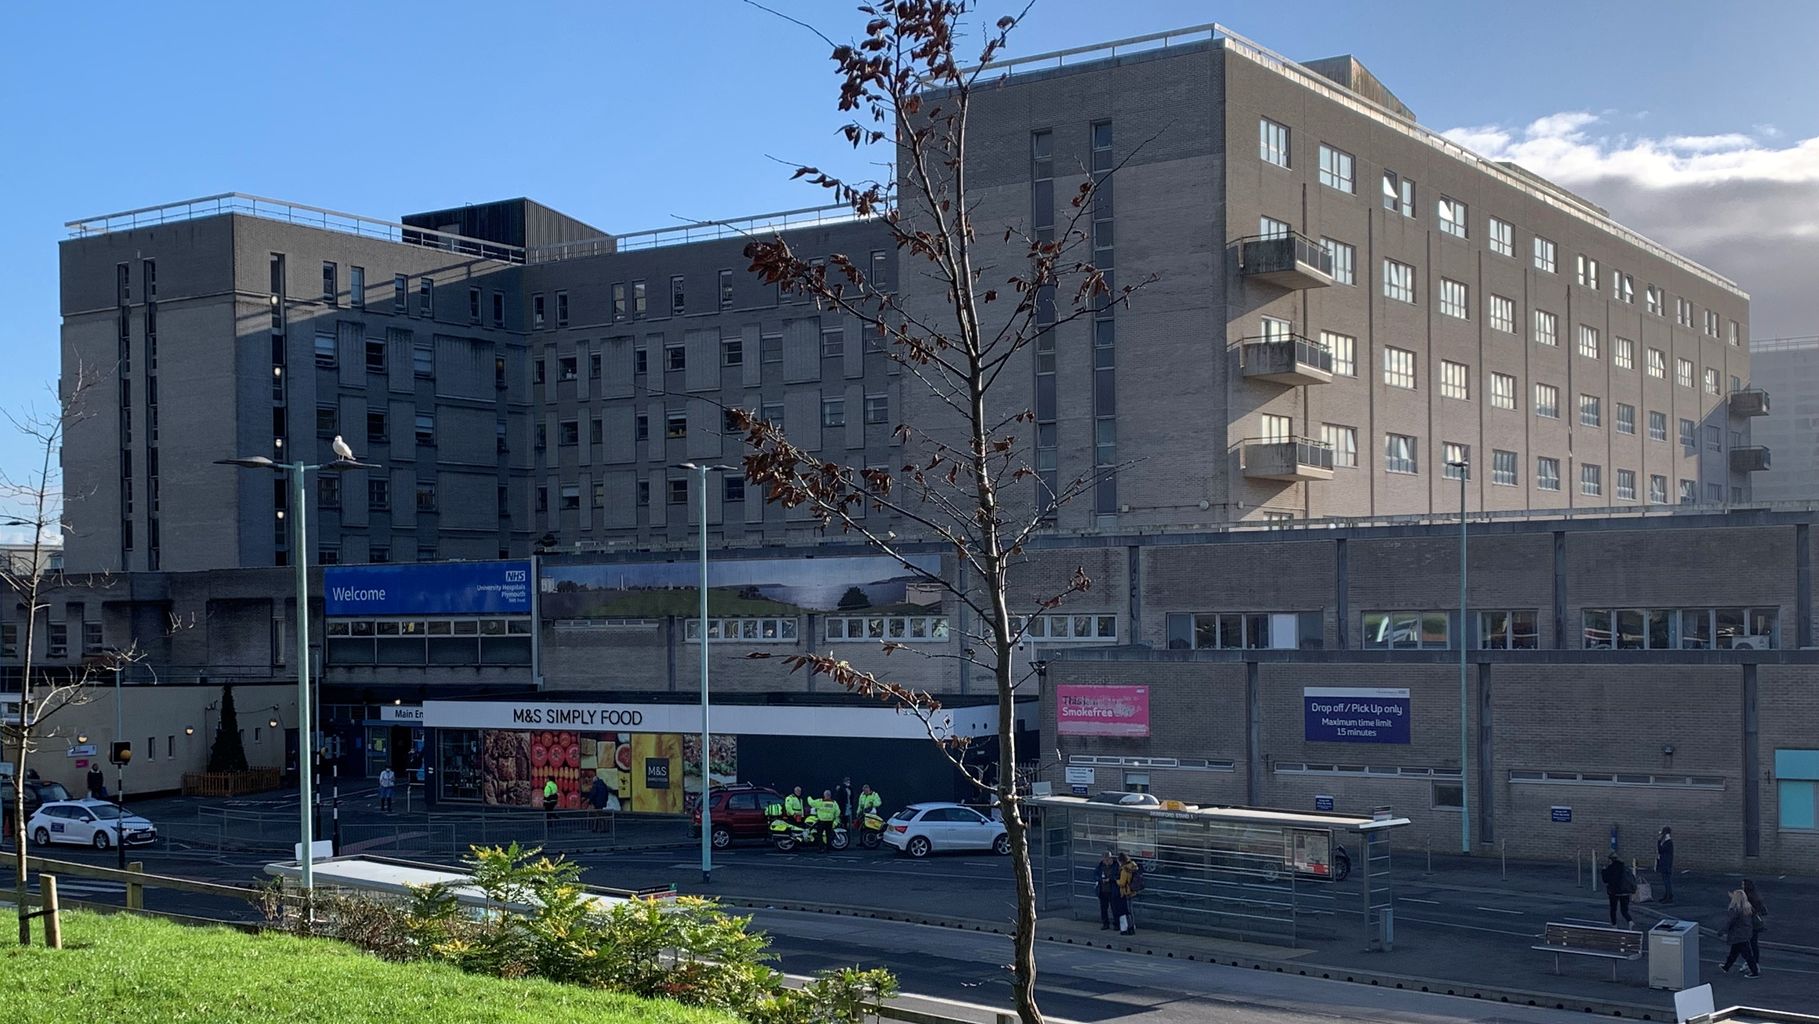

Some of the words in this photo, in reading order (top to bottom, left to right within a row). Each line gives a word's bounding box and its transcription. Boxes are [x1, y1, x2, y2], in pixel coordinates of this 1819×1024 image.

[506, 571, 525, 581] NHS
[332, 586, 386, 601] Welcome
[501, 591, 525, 599] Plymouth
[395, 709, 413, 718] Main
[1062, 706, 1114, 717] Smokefree
[1311, 703, 1332, 714] Drop
[1333, 703, 1345, 712] off
[1351, 703, 1370, 713] Pick
[1370, 704, 1383, 715] Up
[1384, 704, 1403, 716] only
[513, 708, 542, 723] M&S
[546, 709, 597, 725] SIMPLY
[601, 710, 643, 725] FOOD
[1321, 718, 1358, 727] Maximum
[1358, 719, 1375, 727] time
[1375, 719, 1392, 727] limit
[1337, 728, 1347, 736] 15
[1347, 729, 1377, 737] minutes
[648, 766, 667, 776] M&S
